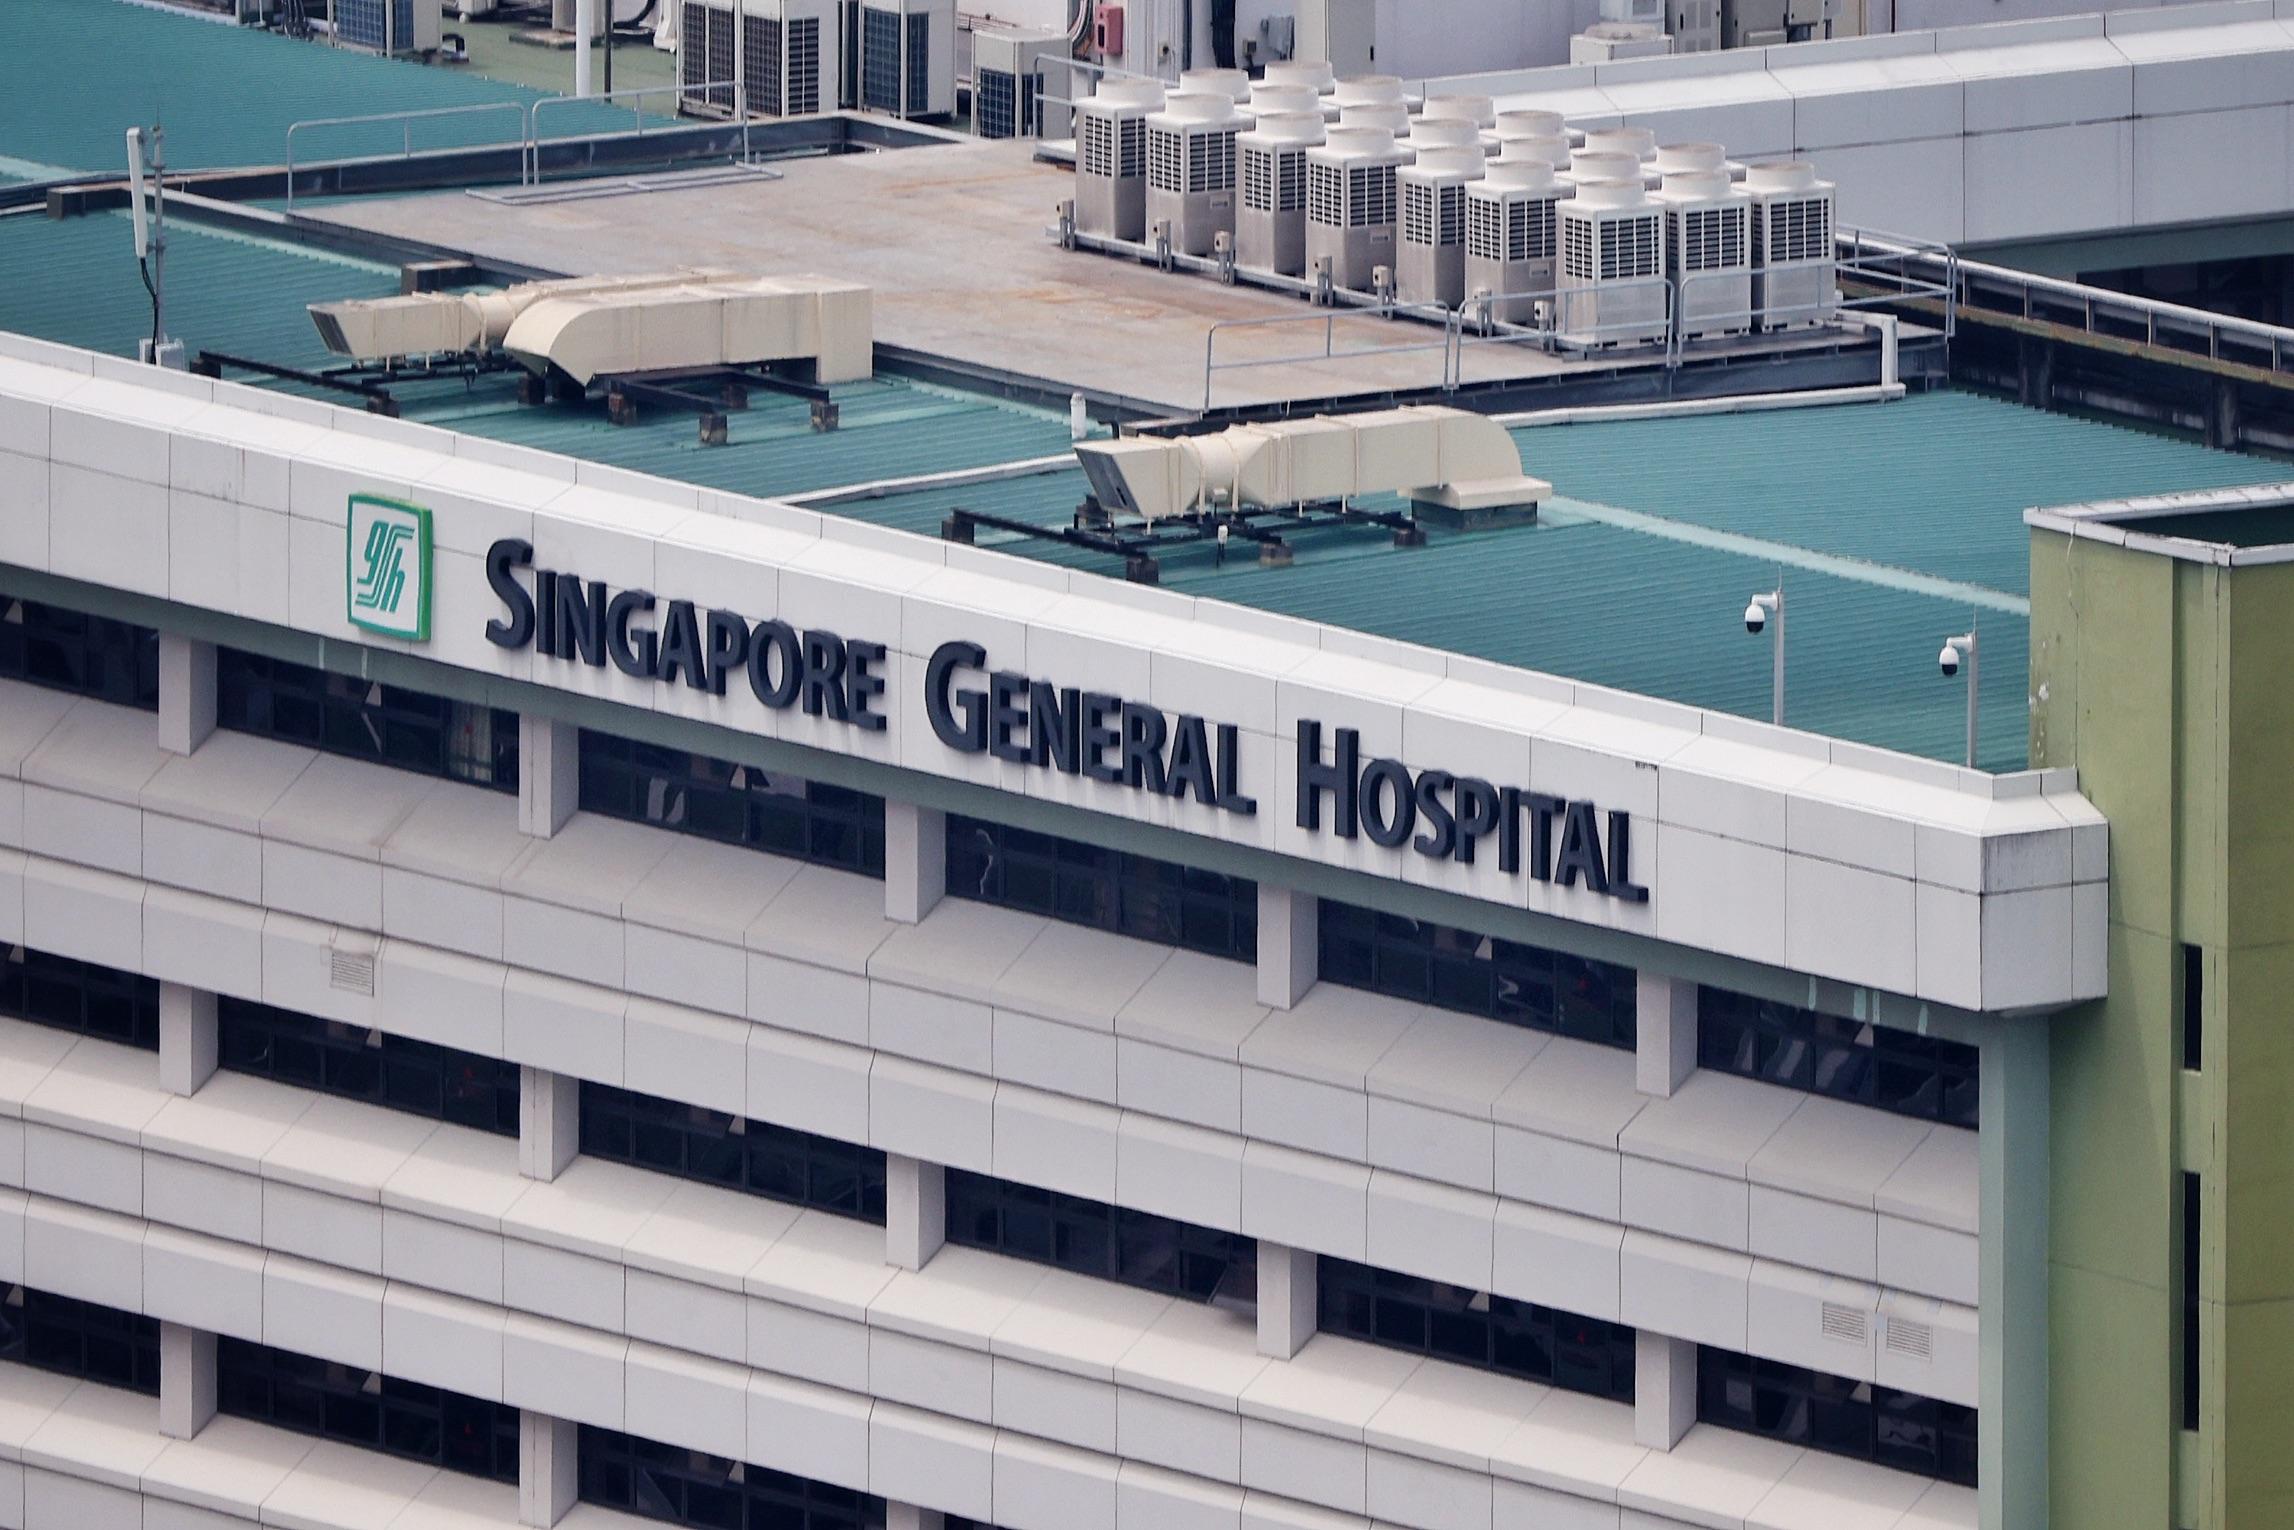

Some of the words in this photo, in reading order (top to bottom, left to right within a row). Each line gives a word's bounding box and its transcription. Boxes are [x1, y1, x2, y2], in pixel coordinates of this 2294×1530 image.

[485, 538, 887, 732] SINGAPORE
[924, 641, 1256, 815] GENERAL
[1297, 718, 1649, 903] HOSPITAL
